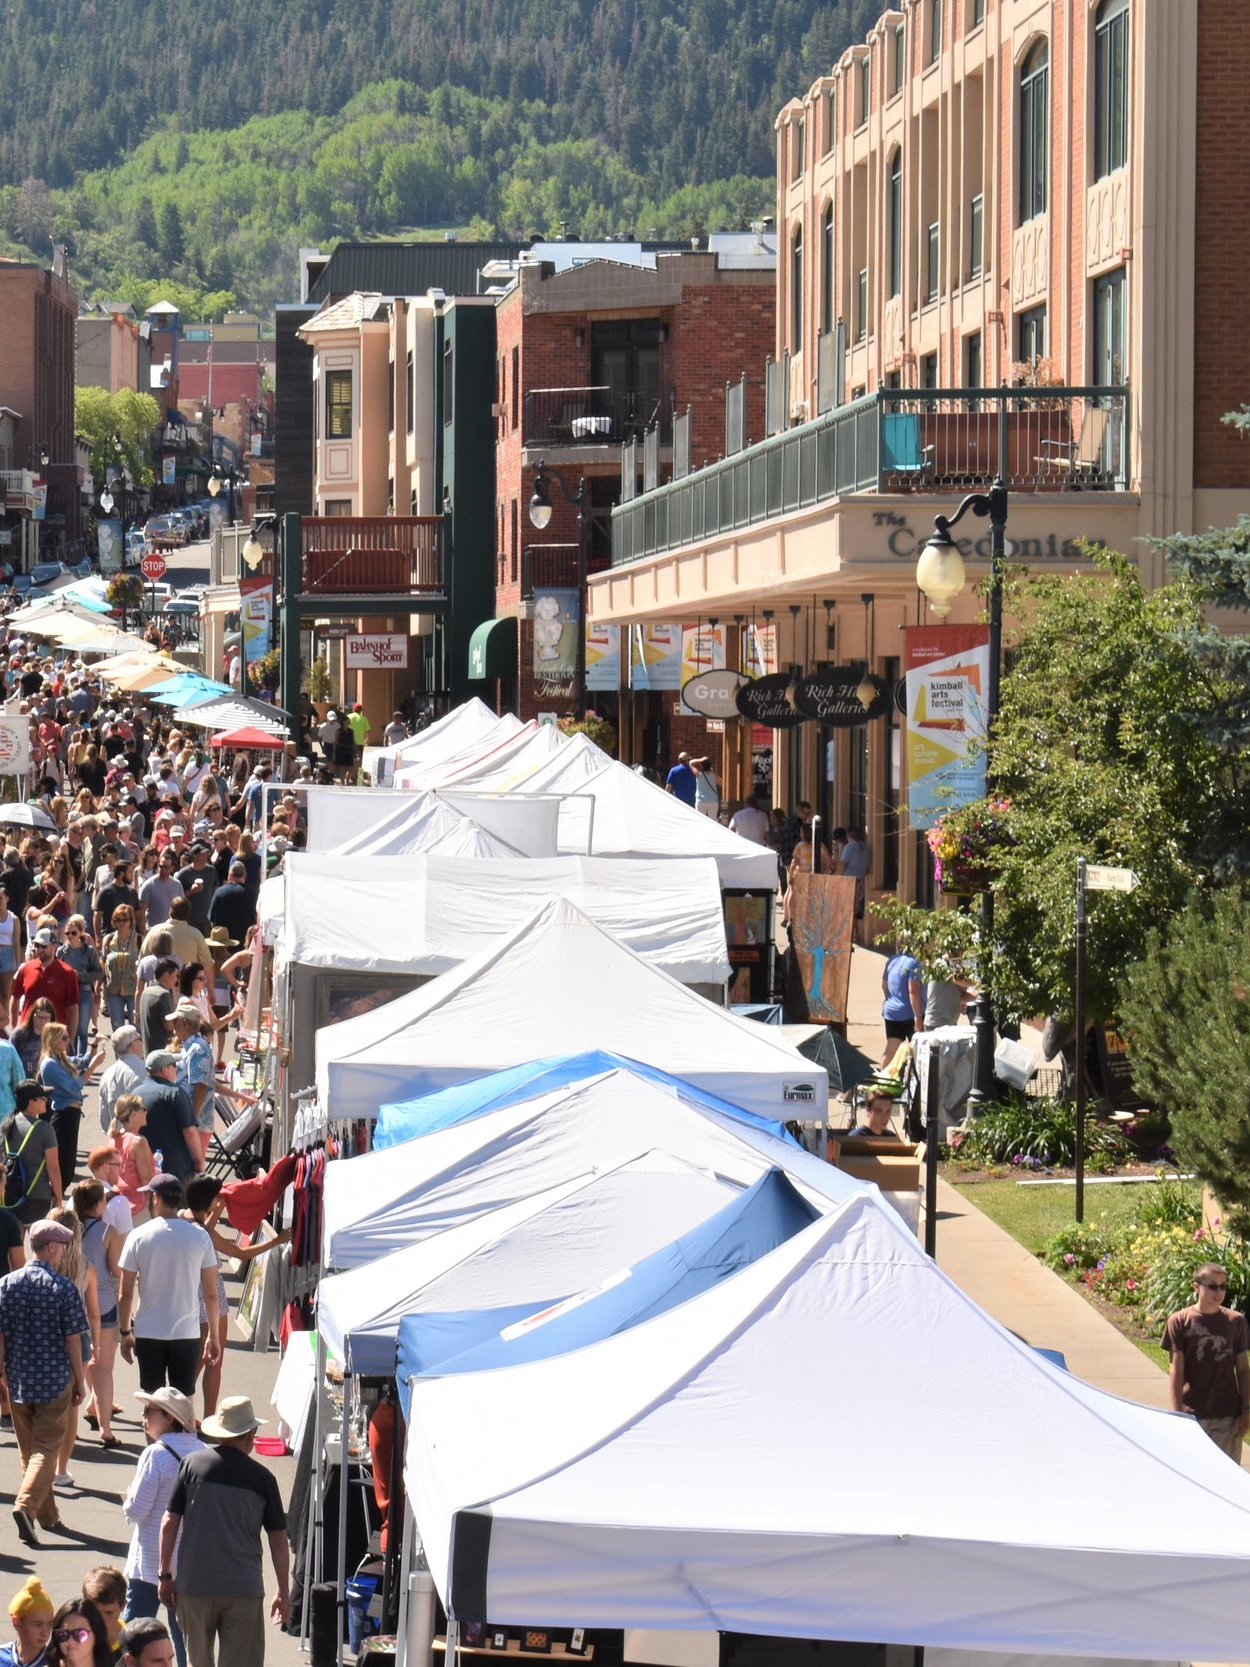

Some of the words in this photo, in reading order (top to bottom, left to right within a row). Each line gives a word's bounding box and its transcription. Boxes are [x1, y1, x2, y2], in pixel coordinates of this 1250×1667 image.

[872, 511, 907, 526] The
[888, 528, 1107, 558] Caedonian
[143, 560, 165, 571] STOP
[930, 681, 963, 690] kimball
[805, 685, 833, 702] Rich
[817, 701, 868, 718] Galleries
[931, 699, 963, 708] festival
[783, 1090, 813, 1100] Eurmax
